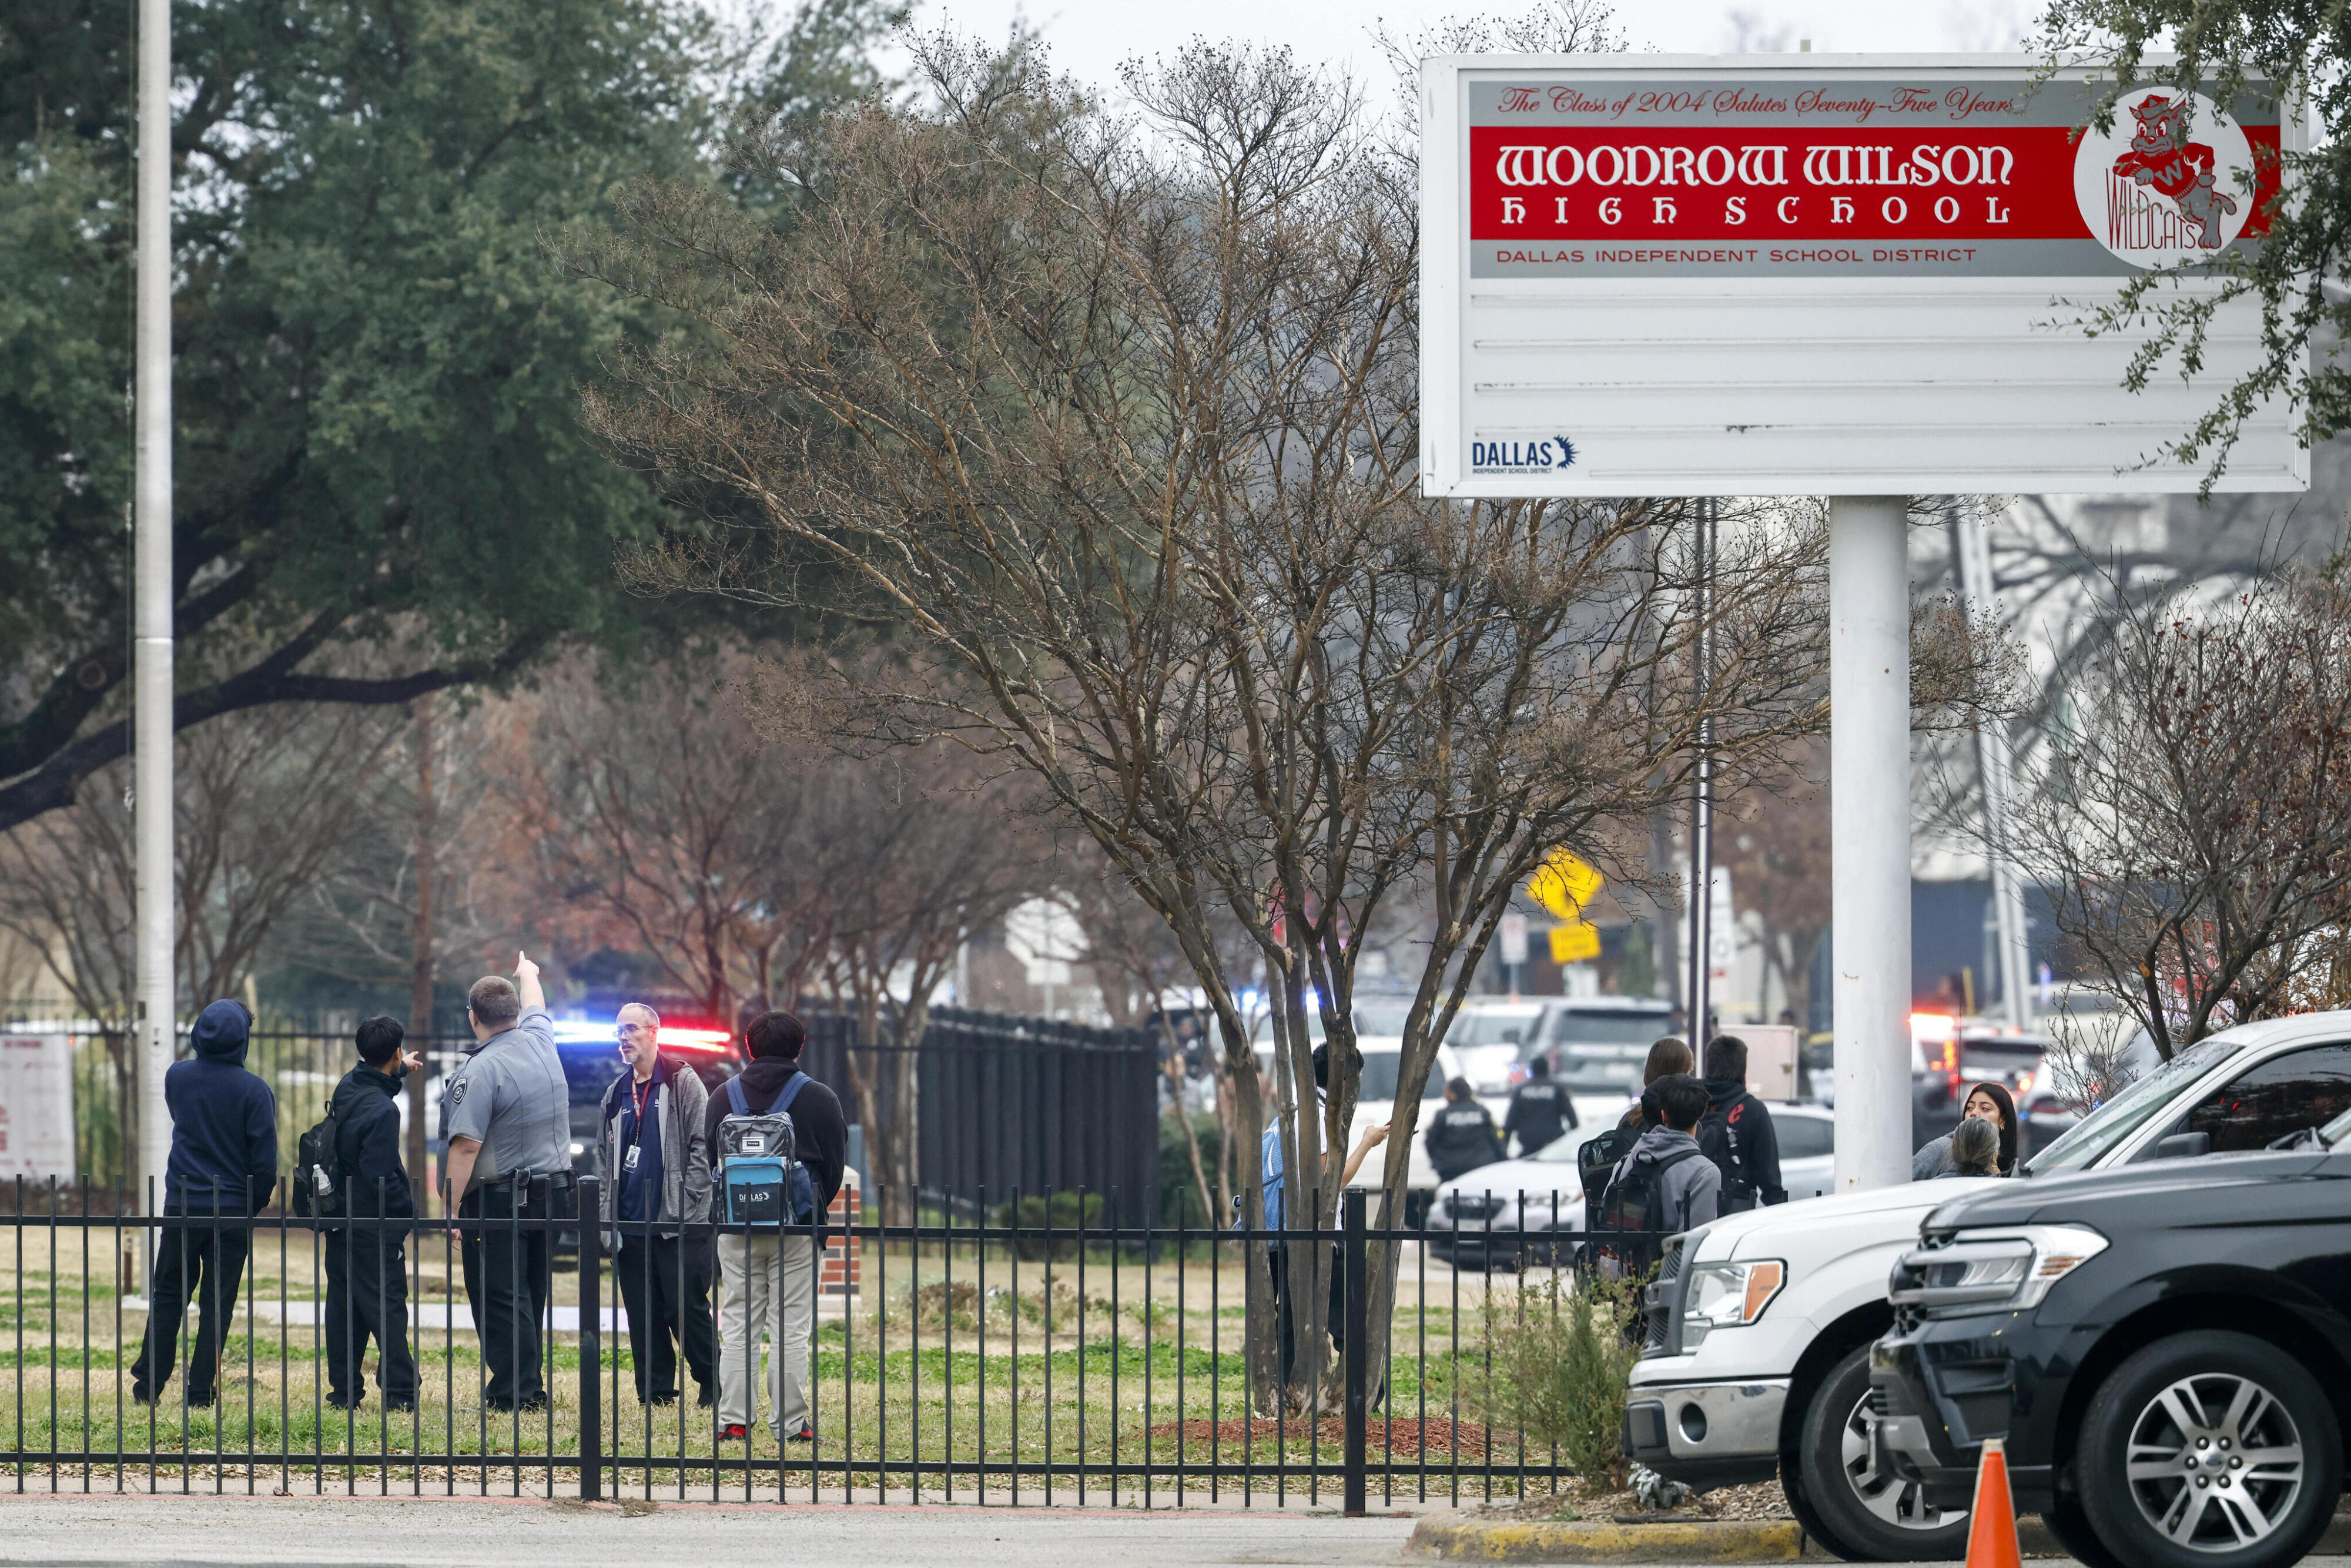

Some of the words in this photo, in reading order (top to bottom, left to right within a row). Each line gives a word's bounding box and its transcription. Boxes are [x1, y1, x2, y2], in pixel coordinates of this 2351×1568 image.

[1498, 86, 1540, 113] The
[1548, 86, 1606, 113] Class
[1610, 92, 1636, 120] of
[1636, 92, 1712, 113] 2004
[1713, 87, 1787, 118] Salutes
[1794, 87, 1938, 123] Seventy-Five
[1944, 86, 2014, 120] Years
[1496, 145, 1789, 186] WOODROW
[1803, 145, 2014, 186] WILSON
[1501, 196, 1677, 226] HIGH
[1724, 196, 2011, 226] SCHOOL
[2105, 167, 2196, 250] WILDCATS
[1496, 250, 1585, 263] DALLAS
[1595, 249, 1759, 263] INDEPENDENT
[1770, 249, 1863, 263] SCHOOL
[1873, 248, 1977, 262] DISTRICT
[1472, 442, 1552, 466] DALLAS
